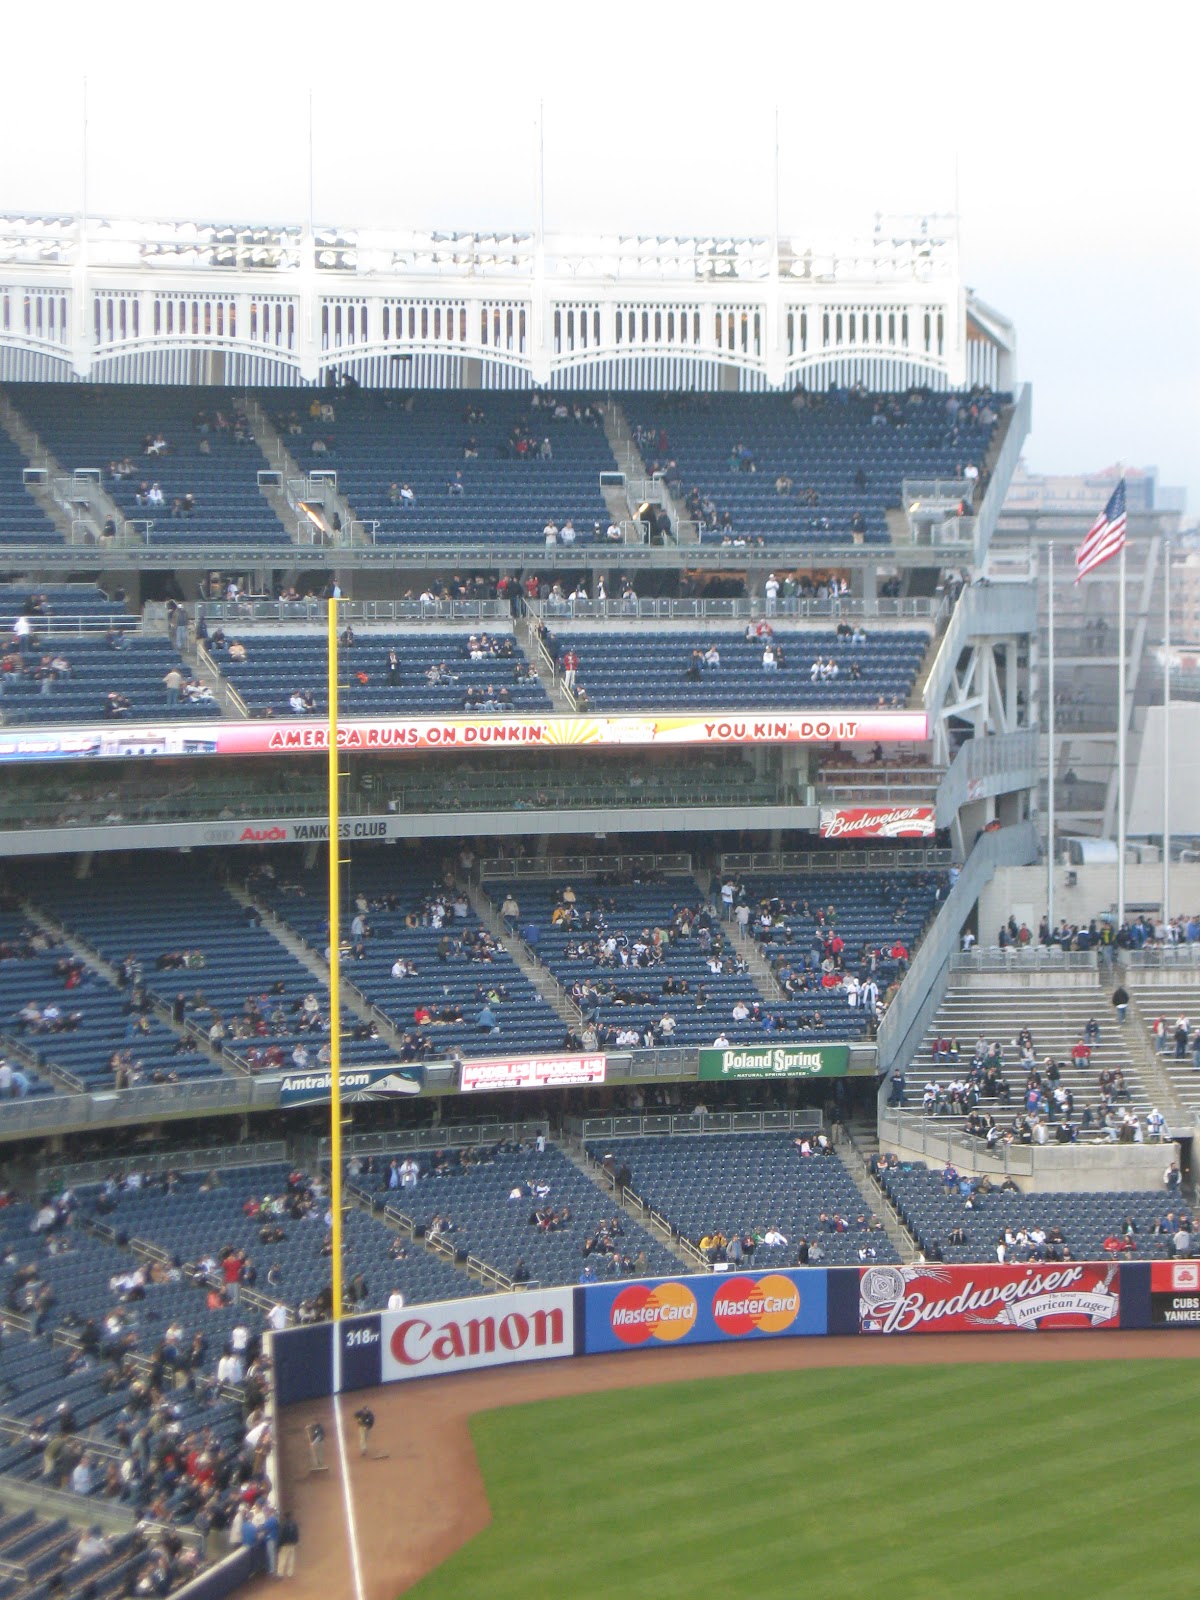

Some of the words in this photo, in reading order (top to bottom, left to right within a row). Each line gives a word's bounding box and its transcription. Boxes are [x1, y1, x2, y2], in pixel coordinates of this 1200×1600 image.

[367, 728, 418, 744] RUNS
[426, 727, 456, 742] ON
[464, 725, 547, 742] DUNKIN'
[704, 723, 746, 738] YOU
[753, 722, 793, 737] KIN'
[801, 722, 831, 737] DO
[839, 722, 857, 737] IT
[239, 826, 287, 841] Audi
[294, 824, 351, 839] YANKES
[354, 822, 387, 837] CLUB
[820, 807, 919, 838] Budweiser
[536, 1059, 602, 1077] MODELL'S
[722, 1049, 772, 1073] Poland
[773, 1049, 821, 1072] Spring
[281, 1073, 369, 1091] Amtrakcom
[465, 1063, 530, 1081] MODELL'S
[714, 1295, 797, 1317] MasterCard
[870, 1265, 1083, 1333] Budweiser
[1018, 1300, 1073, 1319] American
[1076, 1298, 1110, 1312] Lager
[1173, 1298, 1200, 1309] CUBS
[612, 1302, 695, 1326] MasterCard
[390, 1307, 563, 1366] Canon
